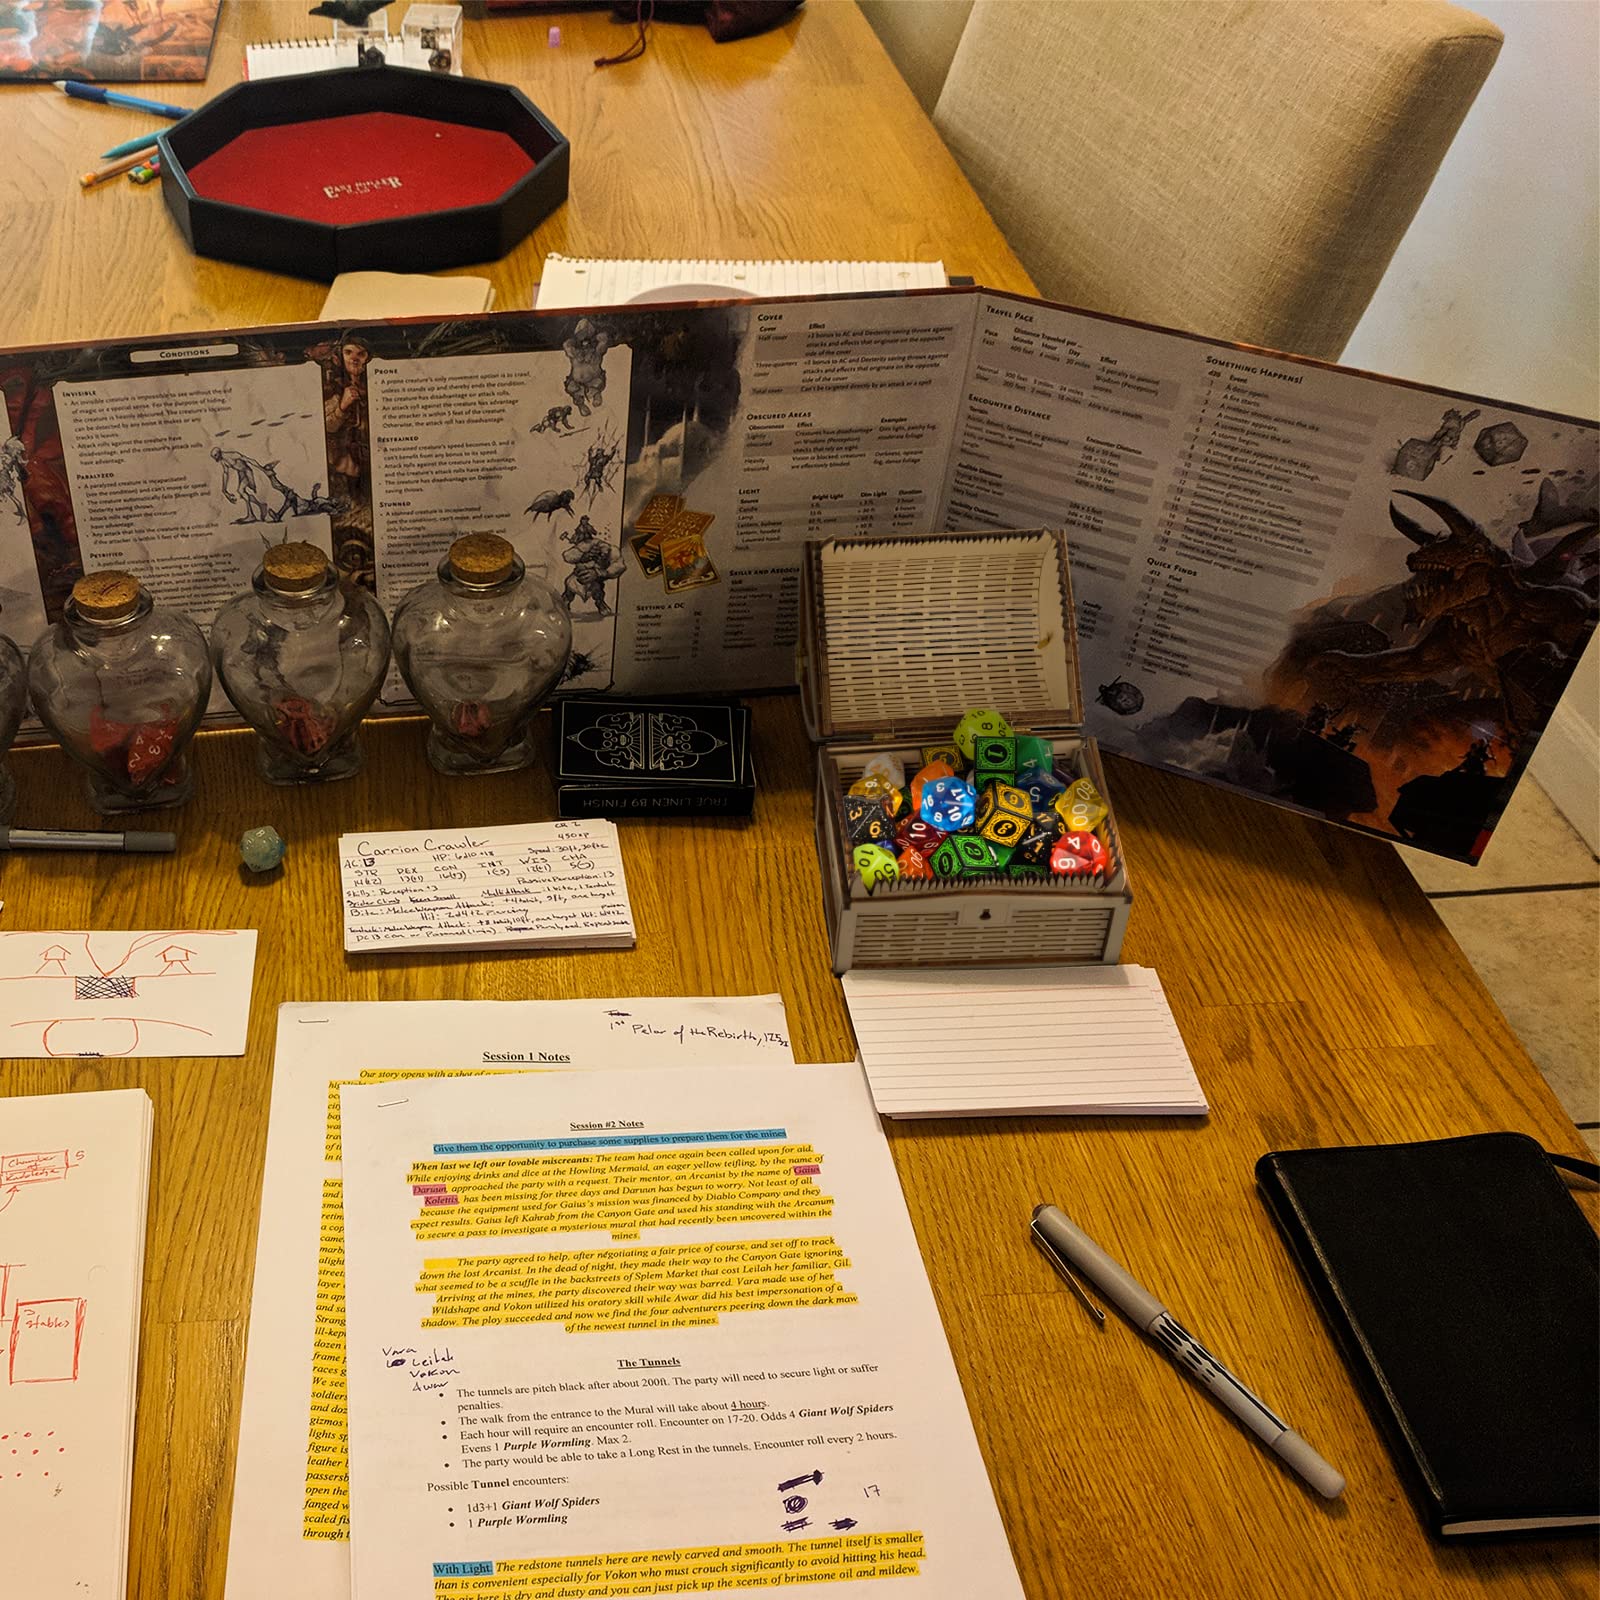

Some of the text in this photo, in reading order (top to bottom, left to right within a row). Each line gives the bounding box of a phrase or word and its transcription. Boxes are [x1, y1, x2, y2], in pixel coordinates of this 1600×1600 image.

[986, 305, 1034, 323] TRAVEL PACE
[968, 393, 1051, 420] ENCOUNTER DISTANCE
[981, 722, 993, 730] 8
[1023, 759, 1037, 767] 4
[936, 783, 945, 792] 3
[583, 800, 626, 808] FINISH
[652, 798, 691, 807] LINEN
[696, 797, 728, 806] TRUE
[849, 806, 863, 821] 3
[934, 812, 943, 822] 8
[948, 806, 962, 822] 10
[909, 823, 926, 839] 10
[357, 835, 490, 856] Carrion Crawler
[1068, 837, 1080, 849] 4
[673, 1025, 683, 1044] of
[482, 1051, 570, 1063] Session 1 Notes
[378, 1071, 399, 1080] story
[401, 1072, 426, 1080] opens
[427, 1070, 445, 1078] with
[570, 1120, 644, 1130] Session #2 Notes
[473, 1160, 488, 1169] left
[508, 1158, 539, 1167] lovable
[543, 1156, 593, 1165] miscreants:
[595, 1154, 612, 1162] The
[638, 1152, 654, 1161] had
[679, 1150, 704, 1160] again
[706, 1149, 727, 1158] been
[729, 1147, 756, 1157] called
[781, 1145, 795, 1155] for
[797, 1145, 813, 1153] aid.
[322, 1191, 339, 1199] and
[317, 1279, 340, 1289] layer
[617, 1357, 681, 1369] The Tunnels
[457, 1388, 475, 1398] The
[478, 1385, 513, 1396] tunnels
[515, 1386, 530, 1394] are
[532, 1382, 556, 1396] pitch
[559, 1380, 586, 1392] black
[588, 1379, 610, 1390] after
[612, 1379, 640, 1389] about
[642, 1377, 670, 1387] 200ft.
[672, 1376, 692, 1386] The
[694, 1375, 719, 1387] party
[721, 1373, 740, 1383] will
[743, 1371, 766, 1381] need
[780, 1370, 811, 1378] secure
[813, 1366, 836, 1378] light
[851, 1363, 879, 1373] suffer
[427, 1475, 569, 1491] Possible Tunnel encounters:
[467, 1495, 600, 1513] 1d3+1 Giant Wolf Spiders
[469, 1513, 568, 1529] 1 Purple Wormling
[433, 1563, 459, 1575] With
[496, 1561, 515, 1572] The
[518, 1560, 562, 1571] redstone
